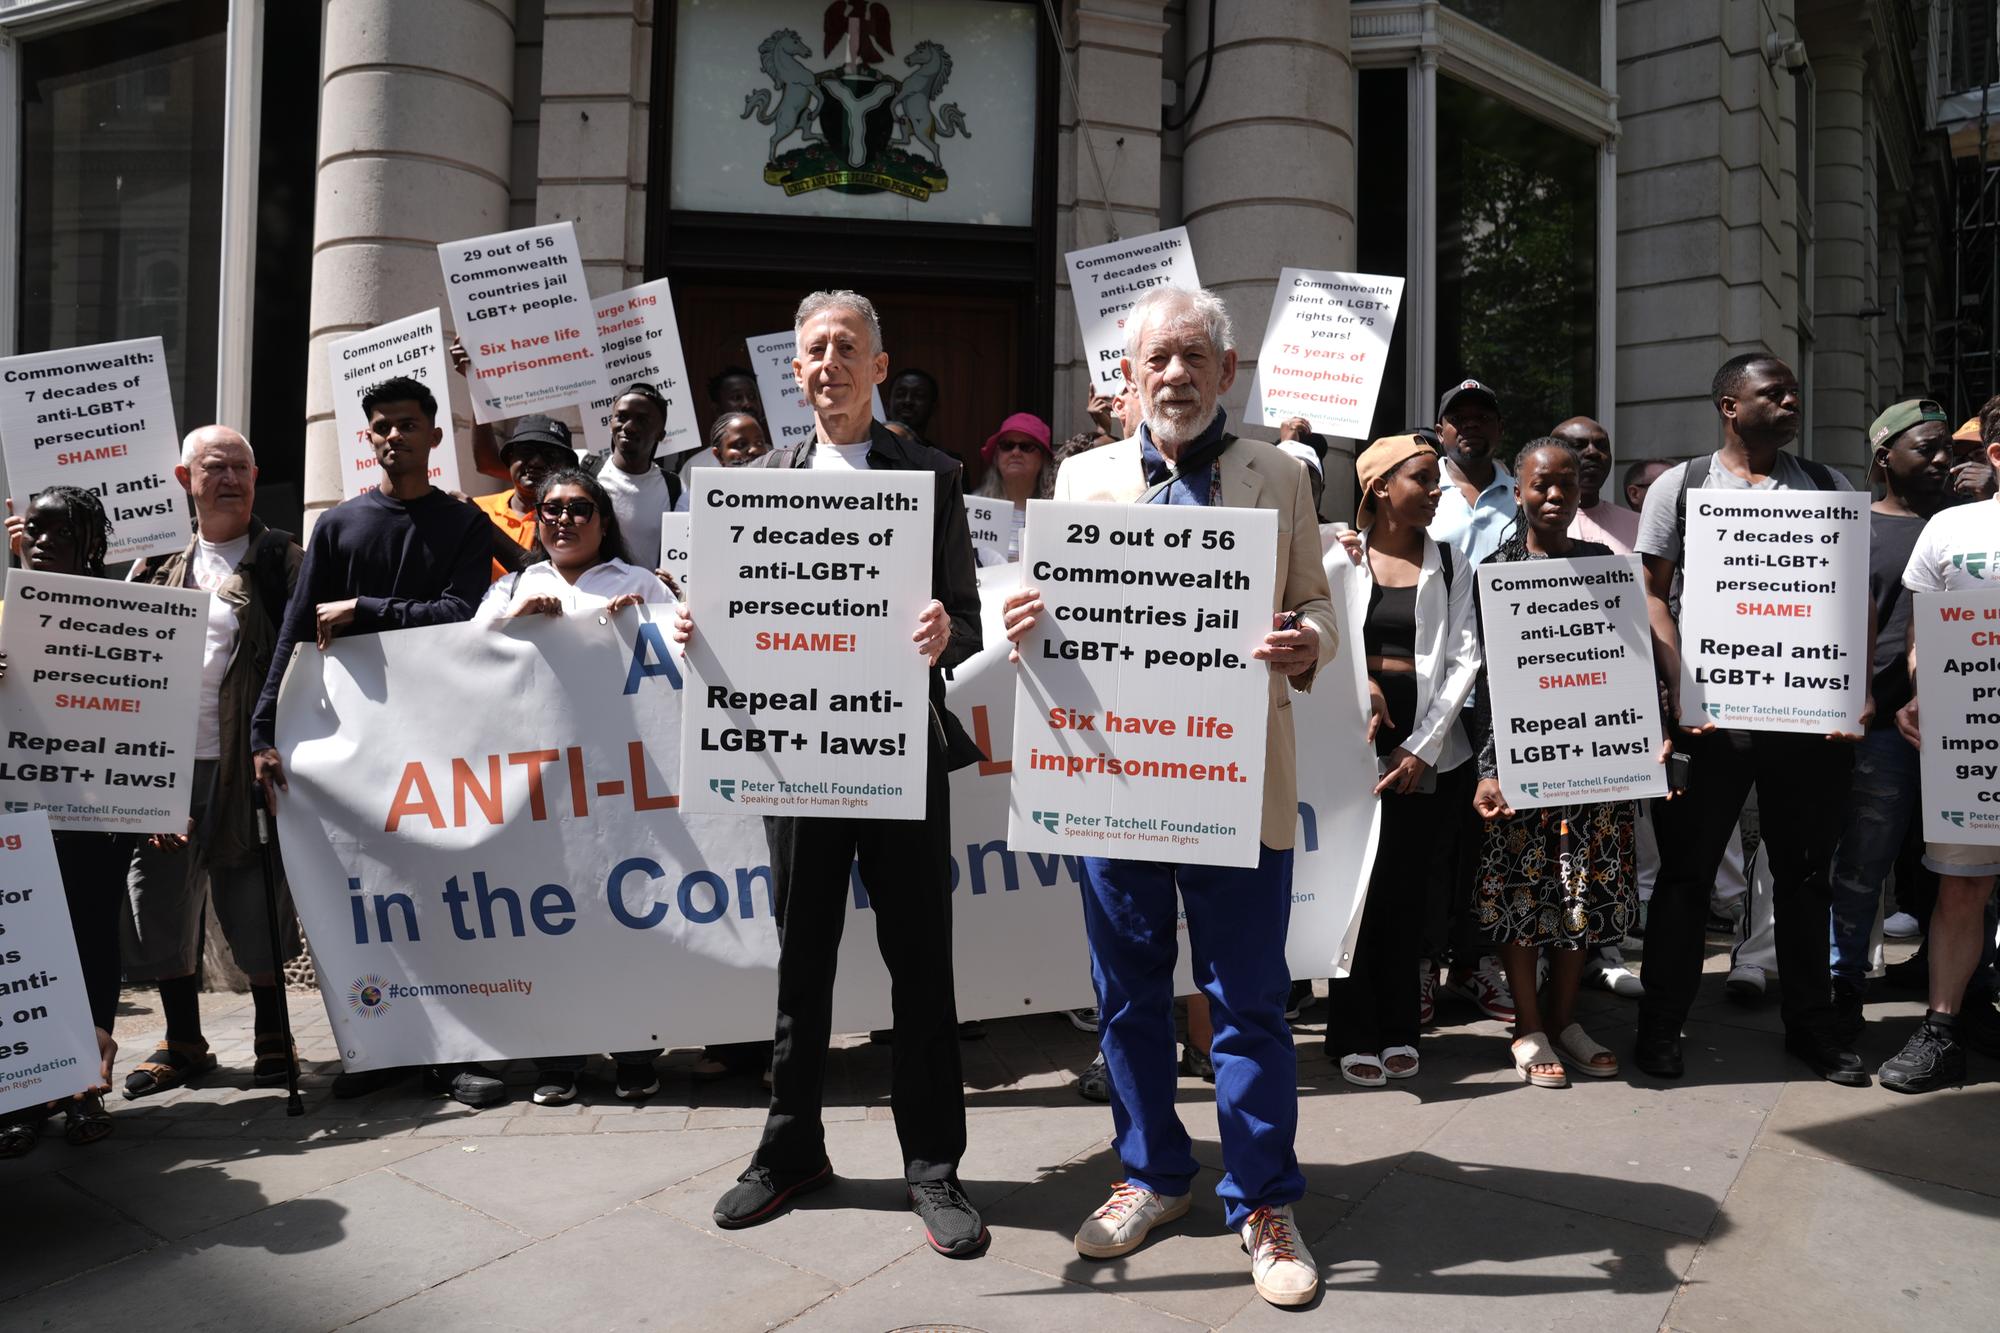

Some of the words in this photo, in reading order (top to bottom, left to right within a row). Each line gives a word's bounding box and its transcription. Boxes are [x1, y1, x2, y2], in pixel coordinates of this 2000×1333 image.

[463, 249, 482, 262] 29
[487, 245, 512, 257] out
[516, 240, 530, 252] of
[536, 236, 554, 248] 56
[1076, 240, 1181, 270] Commonwealth:
[450, 254, 567, 284] Commonwealth
[1091, 274, 1098, 283] 7
[1103, 263, 1157, 280] decades
[1161, 257, 1172, 267] of
[468, 281, 540, 301] countries
[544, 273, 567, 290] jail
[1101, 276, 1170, 298] anti-LGBT+
[1294, 278, 1392, 295] Commonwealth
[467, 305, 517, 322] LGBT+
[522, 294, 577, 314] people.
[597, 305, 624, 319] urge
[628, 296, 656, 310] King
[1289, 295, 1323, 304] silent
[1347, 299, 1390, 311] LGBT+
[1296, 312, 1332, 321] rights
[1337, 315, 1354, 324] for
[1359, 316, 1375, 326] 75
[343, 324, 433, 360] Commonwealth
[480, 343, 506, 356] Six
[511, 335, 550, 350] have
[554, 328, 580, 341] life
[645, 329, 662, 340] for
[1312, 330, 1351, 340] years!
[344, 363, 375, 381] silent
[379, 359, 393, 369] on
[397, 345, 435, 364] LGBT+
[476, 347, 594, 379] imprisonment.
[1283, 344, 1300, 354] 75
[1304, 349, 1344, 359] years
[1350, 352, 1366, 362] of
[4, 353, 154, 383] Commonwealth:
[1273, 365, 1363, 384] homophobic
[25, 390, 35, 403] 7
[42, 382, 118, 400] decades
[123, 375, 140, 388] of
[504, 394, 523, 402] Peter
[525, 386, 555, 398] Tatchell
[555, 379, 596, 393] Foundation
[1267, 389, 1358, 407] persecution
[37, 400, 135, 424] anti-LGBT+
[34, 419, 145, 450] persecution!
[57, 444, 127, 465] SHAME!
[116, 474, 166, 494] anti-
[114, 498, 173, 521] laws!
[707, 489, 918, 511] Commonwealth:
[1699, 504, 1858, 520] Commonwealth:
[730, 526, 744, 543] 7
[753, 526, 860, 546] decades
[868, 528, 894, 546] of
[1066, 524, 1100, 544] 29
[1109, 528, 1154, 547] out
[1164, 529, 1192, 548] of
[1201, 530, 1235, 550] 56
[1717, 529, 1727, 541] 7
[1733, 530, 1814, 544] decades
[1820, 532, 1840, 544] of
[739, 562, 880, 581] anti-LGBT+
[1724, 554, 1829, 568] anti-LGBT+
[1033, 561, 1250, 590] Commonwealth
[1491, 570, 1634, 592] Commonwealth:
[1716, 580, 1836, 593] persecution!
[20, 586, 197, 618] Commonwealth:
[729, 598, 888, 618] persecution!
[1510, 603, 1520, 616] 7
[1527, 598, 1599, 615] decades
[1604, 595, 1621, 609] of
[1736, 602, 1811, 617] SHAME!
[1055, 605, 1187, 627] countries
[1194, 608, 1238, 633] jail
[1940, 607, 1975, 622] We
[39, 614, 52, 628] 7
[59, 617, 148, 638] decades
[155, 628, 176, 640] of
[1521, 622, 1616, 640] anti-LGBT+
[755, 632, 856, 652] SHAME!
[1700, 638, 1782, 660] Repeal
[1791, 644, 1847, 660] anti-
[44, 644, 163, 663] anti-LGBT+
[1043, 639, 1134, 662] LGBT+
[1145, 648, 1246, 672] people.
[1517, 645, 1625, 669] persecution!
[33, 669, 168, 690] persecution!
[1539, 672, 1607, 689] SHAME!
[1696, 667, 1775, 686] LGBT+
[1784, 672, 1849, 690] laws!
[55, 694, 140, 713] SHAME!
[707, 685, 817, 715] Repeal
[829, 690, 903, 713] anti-
[1725, 704, 1750, 716] Peter
[1752, 705, 1790, 715] Tatchell
[1792, 707, 1847, 718] Foundation
[1047, 707, 1095, 731] Six
[1105, 711, 1176, 736] have
[1187, 716, 1233, 739] life
[1510, 712, 1587, 736] Repeal
[1594, 708, 1643, 727] anti-
[1724, 713, 1753, 723] Speaking
[8, 731, 106, 755] Repeal
[114, 741, 175, 757] anti-
[701, 728, 808, 753] LGBT+
[820, 731, 906, 756] laws!
[1510, 744, 1584, 764] LGBT+
[1592, 737, 1649, 757] laws!
[0, 763, 95, 783] LGBT+
[105, 768, 176, 788] laws!
[1031, 748, 1247, 783] imprisonment.
[1956, 765, 1998, 780] gay
[741, 780, 775, 796] Peter
[778, 781, 828, 794] Tatchell
[831, 782, 902, 796] Foundation
[1542, 781, 1565, 790] Peter
[1567, 777, 1602, 788] Tatchell
[1603, 773, 1651, 785] Foundation
[1542, 789, 1570, 799] Speaking
[1612, 785, 1629, 793] Rights
[66, 803, 109, 814] Tatchell
[112, 805, 170, 816] Foundation
[740, 795, 779, 806] Speaking
[796, 796, 809, 805] for
[810, 796, 840, 805] Human
[842, 797, 868, 808] Rights
[1066, 813, 1101, 829] Peter
[1104, 816, 1157, 830] Tatchell
[1161, 820, 1236, 836] Foundation
[1065, 827, 1105, 840] Speaking
[1123, 831, 1136, 840] for
[1138, 833, 1169, 842] Human
[1171, 834, 1199, 846] Rights
[347, 877, 421, 944] in
[441, 871, 576, 941] the
[388, 979, 532, 999] #commonequality
[13, 1006, 48, 1023] on
